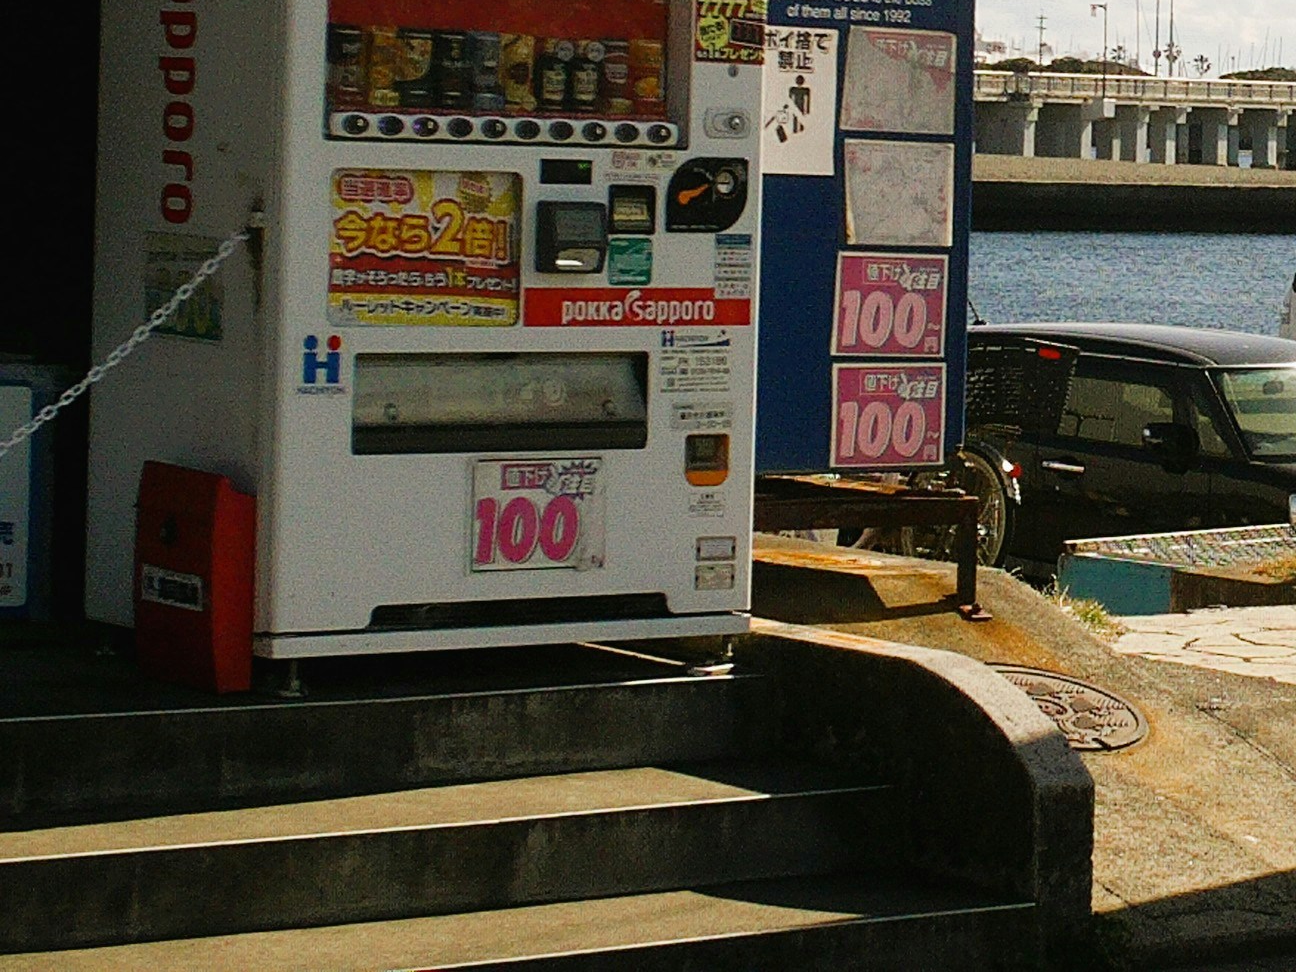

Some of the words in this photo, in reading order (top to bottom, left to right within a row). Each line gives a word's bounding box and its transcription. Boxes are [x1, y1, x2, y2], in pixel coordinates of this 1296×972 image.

[786, 4, 800, 18] of
[801, 5, 831, 19] them
[834, 6, 849, 20] all
[850, 7, 880, 21] since
[884, 9, 911, 23] 1992
[778, 51, 813, 70] 禁止
[841, 290, 927, 348] 100
[839, 401, 925, 458] 100
[475, 496, 579, 564] 100
